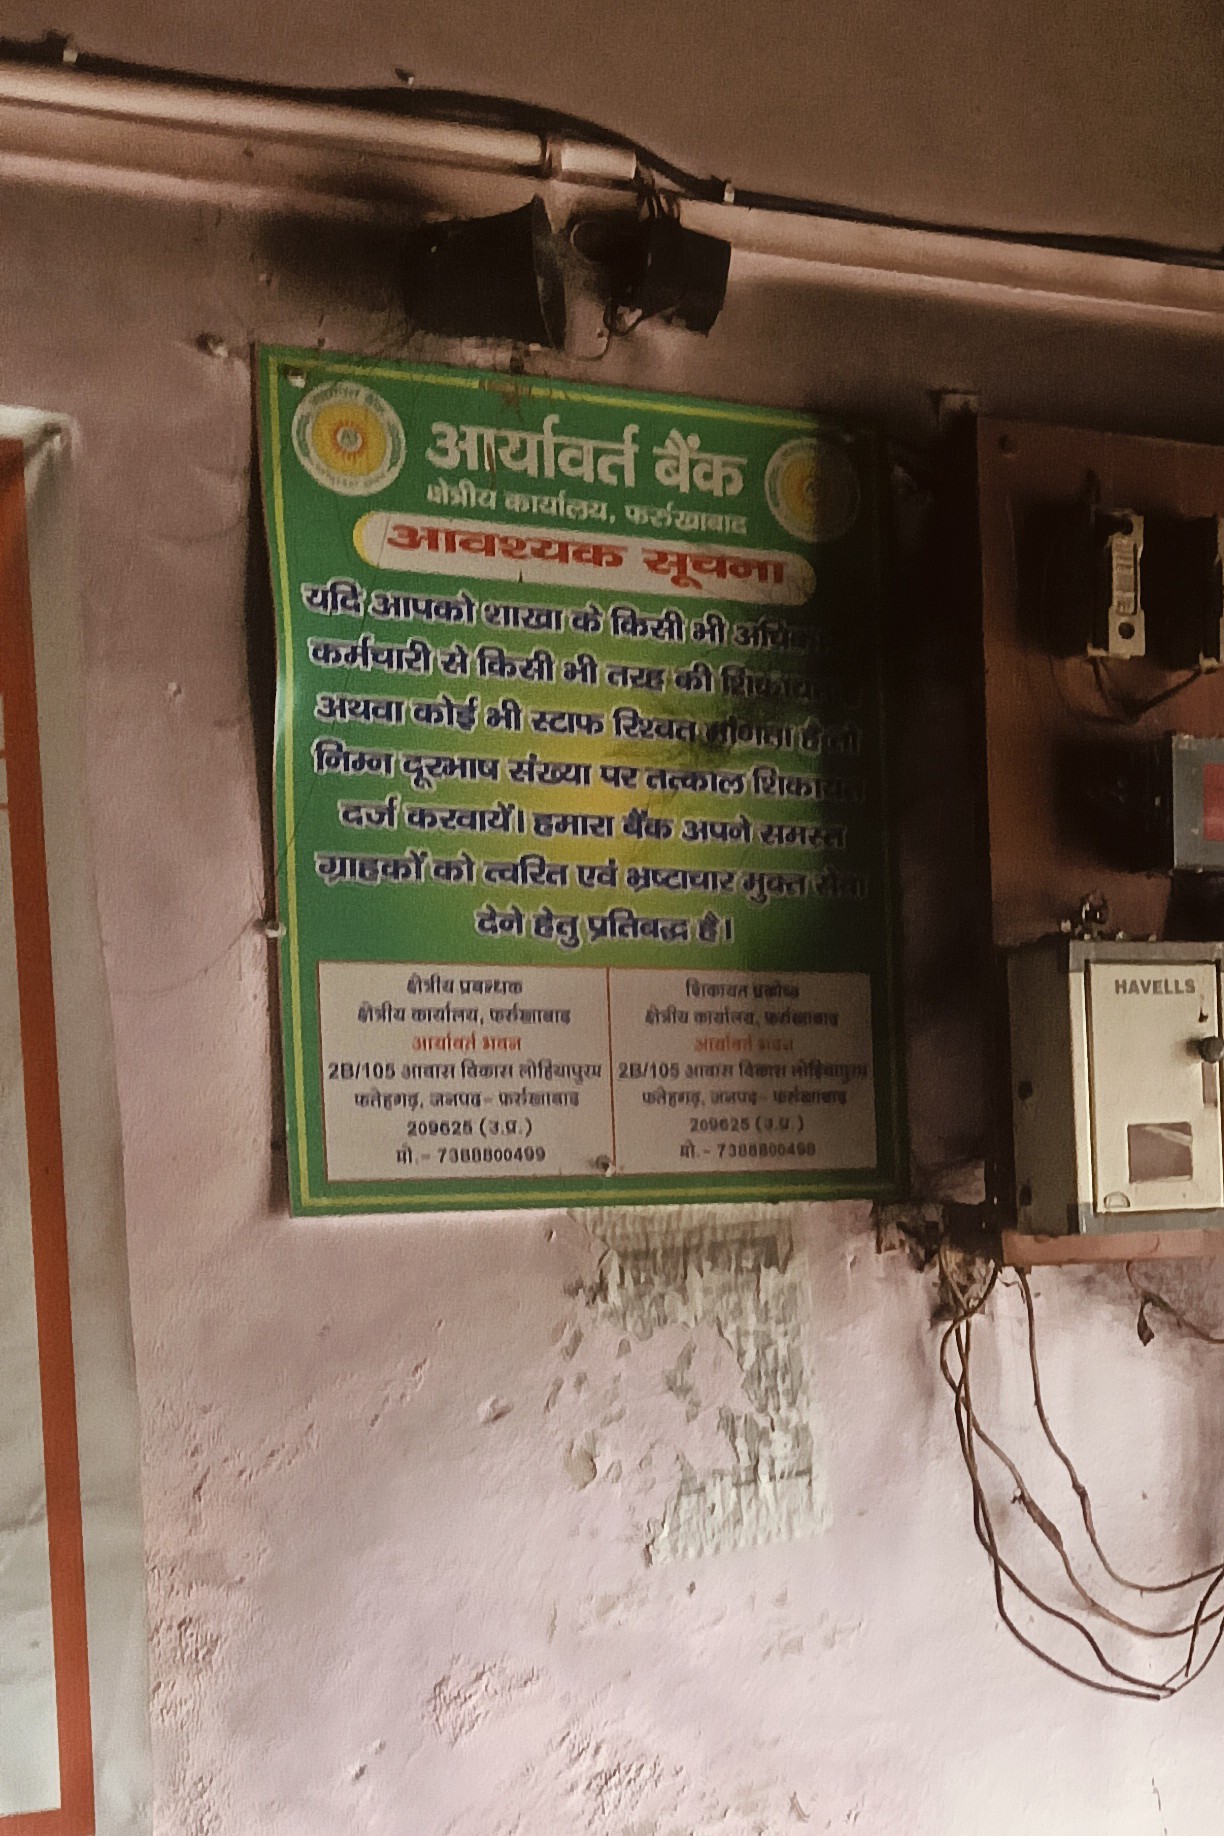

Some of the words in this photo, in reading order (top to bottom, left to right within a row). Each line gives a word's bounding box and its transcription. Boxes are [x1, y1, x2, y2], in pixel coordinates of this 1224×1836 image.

[426, 414, 640, 487] आर्यावर्त
[653, 428, 748, 497] बैंक
[427, 477, 496, 510] क्षेत्रीय
[387, 524, 629, 567] आवश्यक
[642, 547, 787, 590] सूचना
[302, 576, 366, 618] यदि
[369, 589, 479, 627] आपको
[481, 601, 566, 633] शाखा
[568, 600, 603, 635] के
[608, 602, 687, 645] किसी
[691, 609, 728, 647] भी
[307, 631, 434, 675] कर्मचारी
[437, 643, 471, 678] से
[474, 643, 556, 683] किसी
[561, 651, 598, 687] भी
[605, 663, 668, 694] तरह
[672, 659, 715, 695] की
[314, 690, 407, 725] अथवा
[410, 692, 481, 734] कोई
[485, 697, 524, 732] भी
[528, 708, 606, 736] स्टाफ
[611, 705, 700, 742] रिश्वत
[311, 735, 397, 778] निम्न
[400, 750, 500, 792] दूरभाष
[506, 752, 592, 787] संख्या
[600, 763, 640, 789] पर
[643, 765, 747, 797] तत्काल
[337, 792, 402, 830] दर्ज
[531, 811, 614, 838] हमारा
[620, 806, 675, 842] बैंक
[680, 810, 753, 844] अपने
[314, 845, 431, 887] ग्राहकों
[431, 848, 479, 886] को
[482, 851, 571, 887] त्वरित
[575, 856, 618, 889] एवं
[625, 866, 736, 894] भ्रष्टाचार
[740, 868, 809, 905] मुक्त
[473, 902, 526, 938] देने
[530, 903, 583, 950] हेतु
[585, 905, 692, 944] प्रतिबद्ध
[1114, 977, 1197, 996] HAVELLS
[328, 1061, 396, 1080] 2B/105
[618, 1062, 679, 1082] 2B/105
[407, 1119, 473, 1136] 209625
